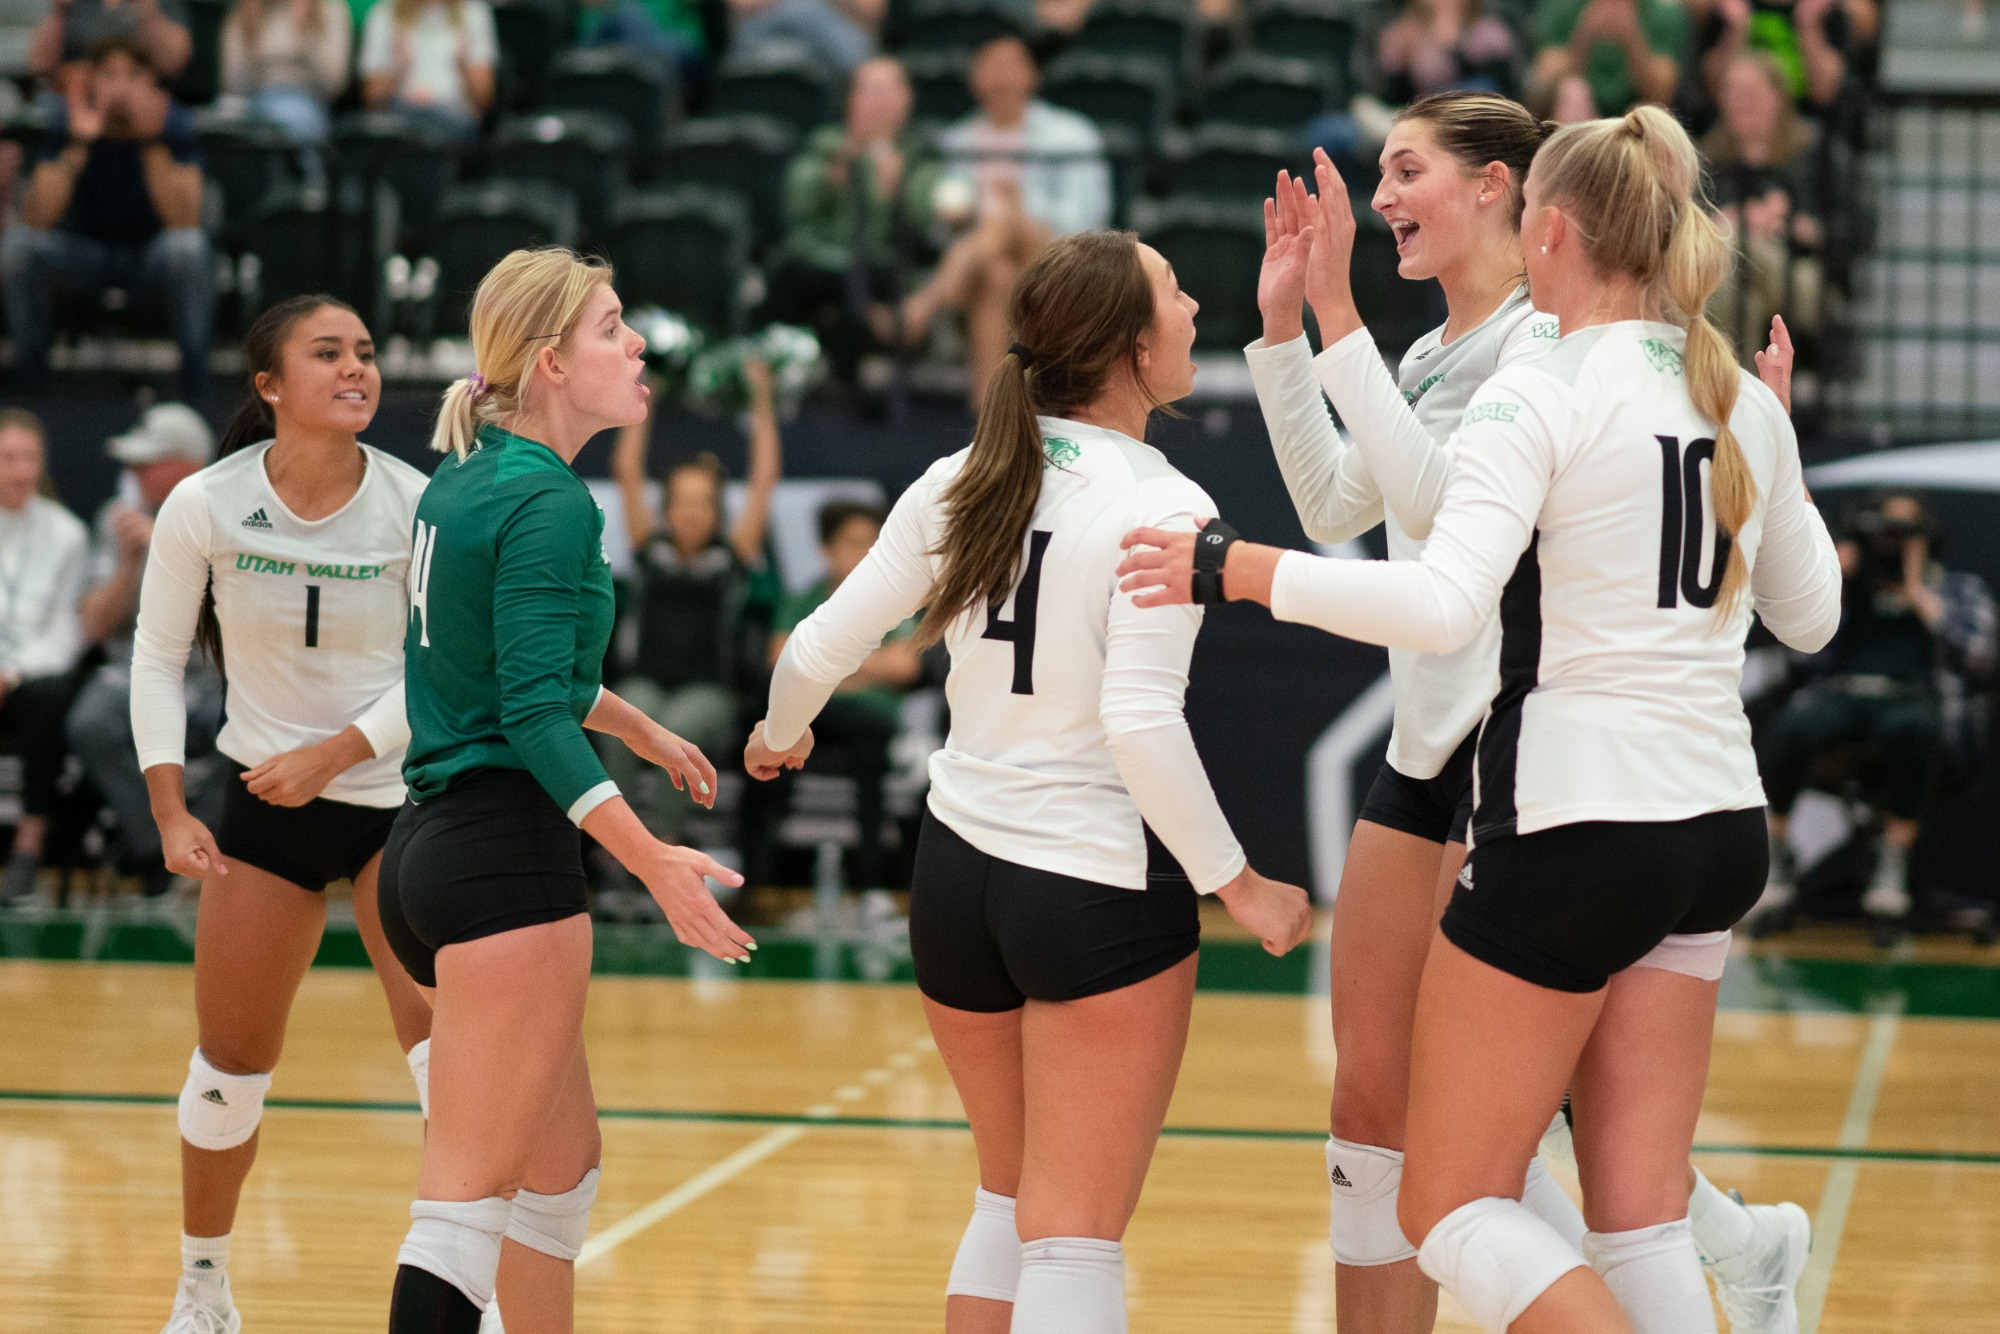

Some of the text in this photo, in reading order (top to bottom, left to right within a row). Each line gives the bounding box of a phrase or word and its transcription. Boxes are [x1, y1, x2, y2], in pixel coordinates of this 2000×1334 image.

[1465, 402, 1520, 426] WAC
[241, 519, 273, 529] adidas
[1653, 434, 1732, 609] 10
[235, 553, 298, 576] UTAH
[304, 563, 389, 581] VALLEY
[304, 584, 321, 648] 1
[980, 529, 1053, 696] 4
